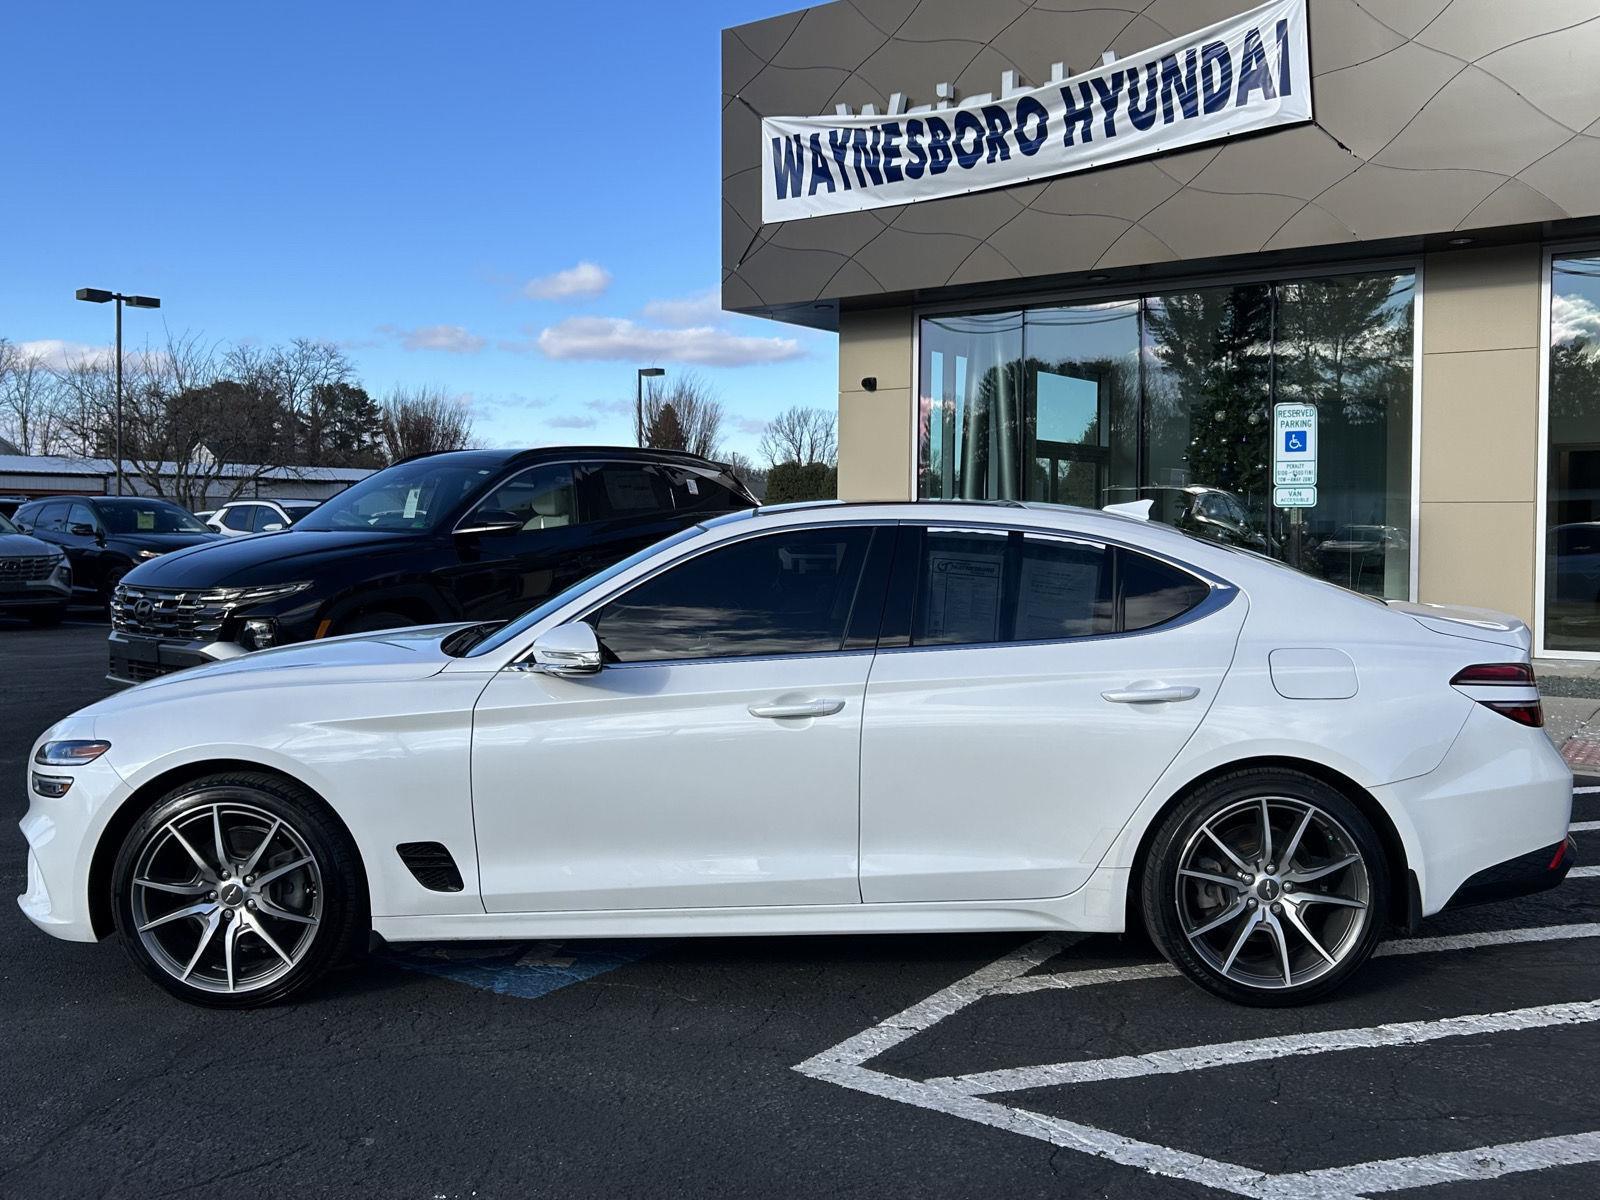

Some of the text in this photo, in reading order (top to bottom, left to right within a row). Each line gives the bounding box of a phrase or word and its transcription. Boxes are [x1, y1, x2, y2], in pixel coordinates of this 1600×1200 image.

[771, 96, 1049, 200] WAYNESBORO
[1059, 19, 1293, 148] HYUNDAI
[1278, 409, 1314, 418] RESERVED
[1280, 420, 1312, 428] PARKING
